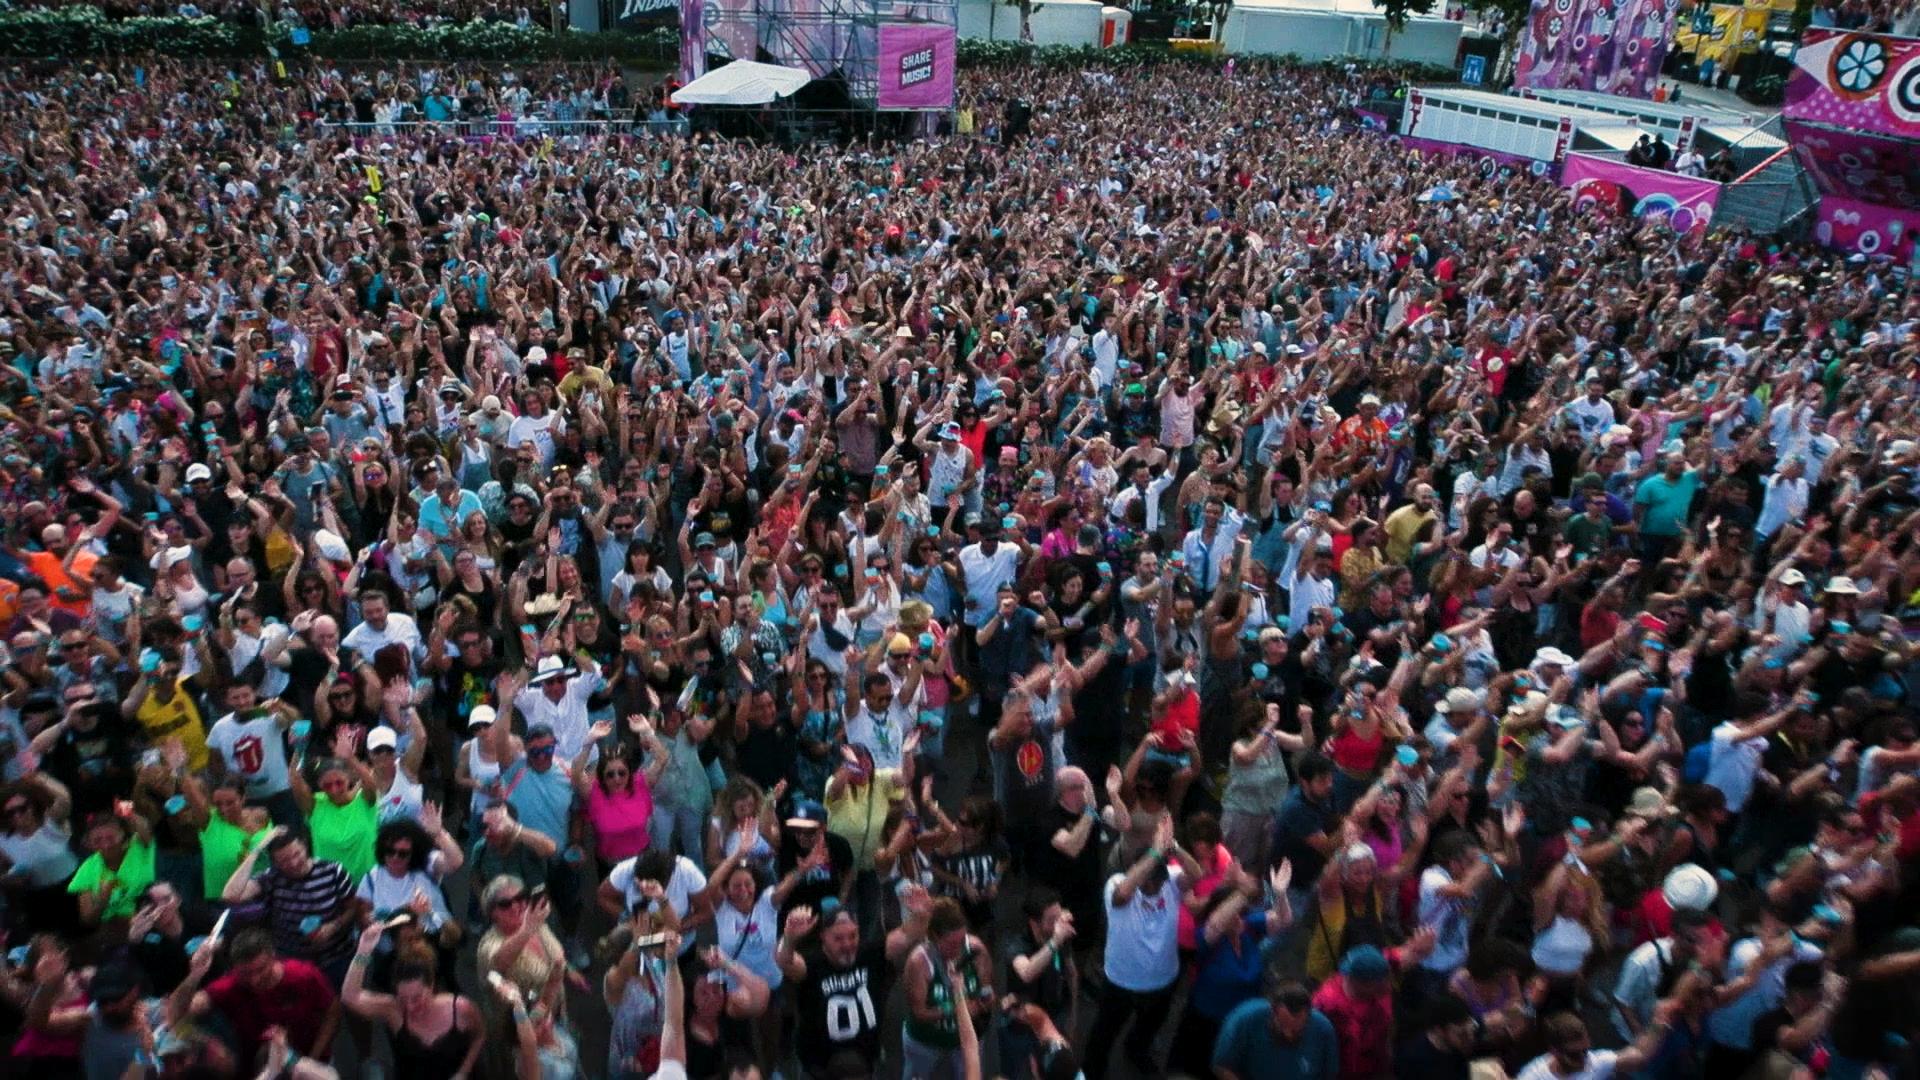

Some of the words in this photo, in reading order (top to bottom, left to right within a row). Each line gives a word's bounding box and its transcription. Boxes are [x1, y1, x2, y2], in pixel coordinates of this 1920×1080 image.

[902, 49, 932, 69] SHARE
[902, 65, 931, 85] MUSIC!
[827, 985, 877, 1040] 01
